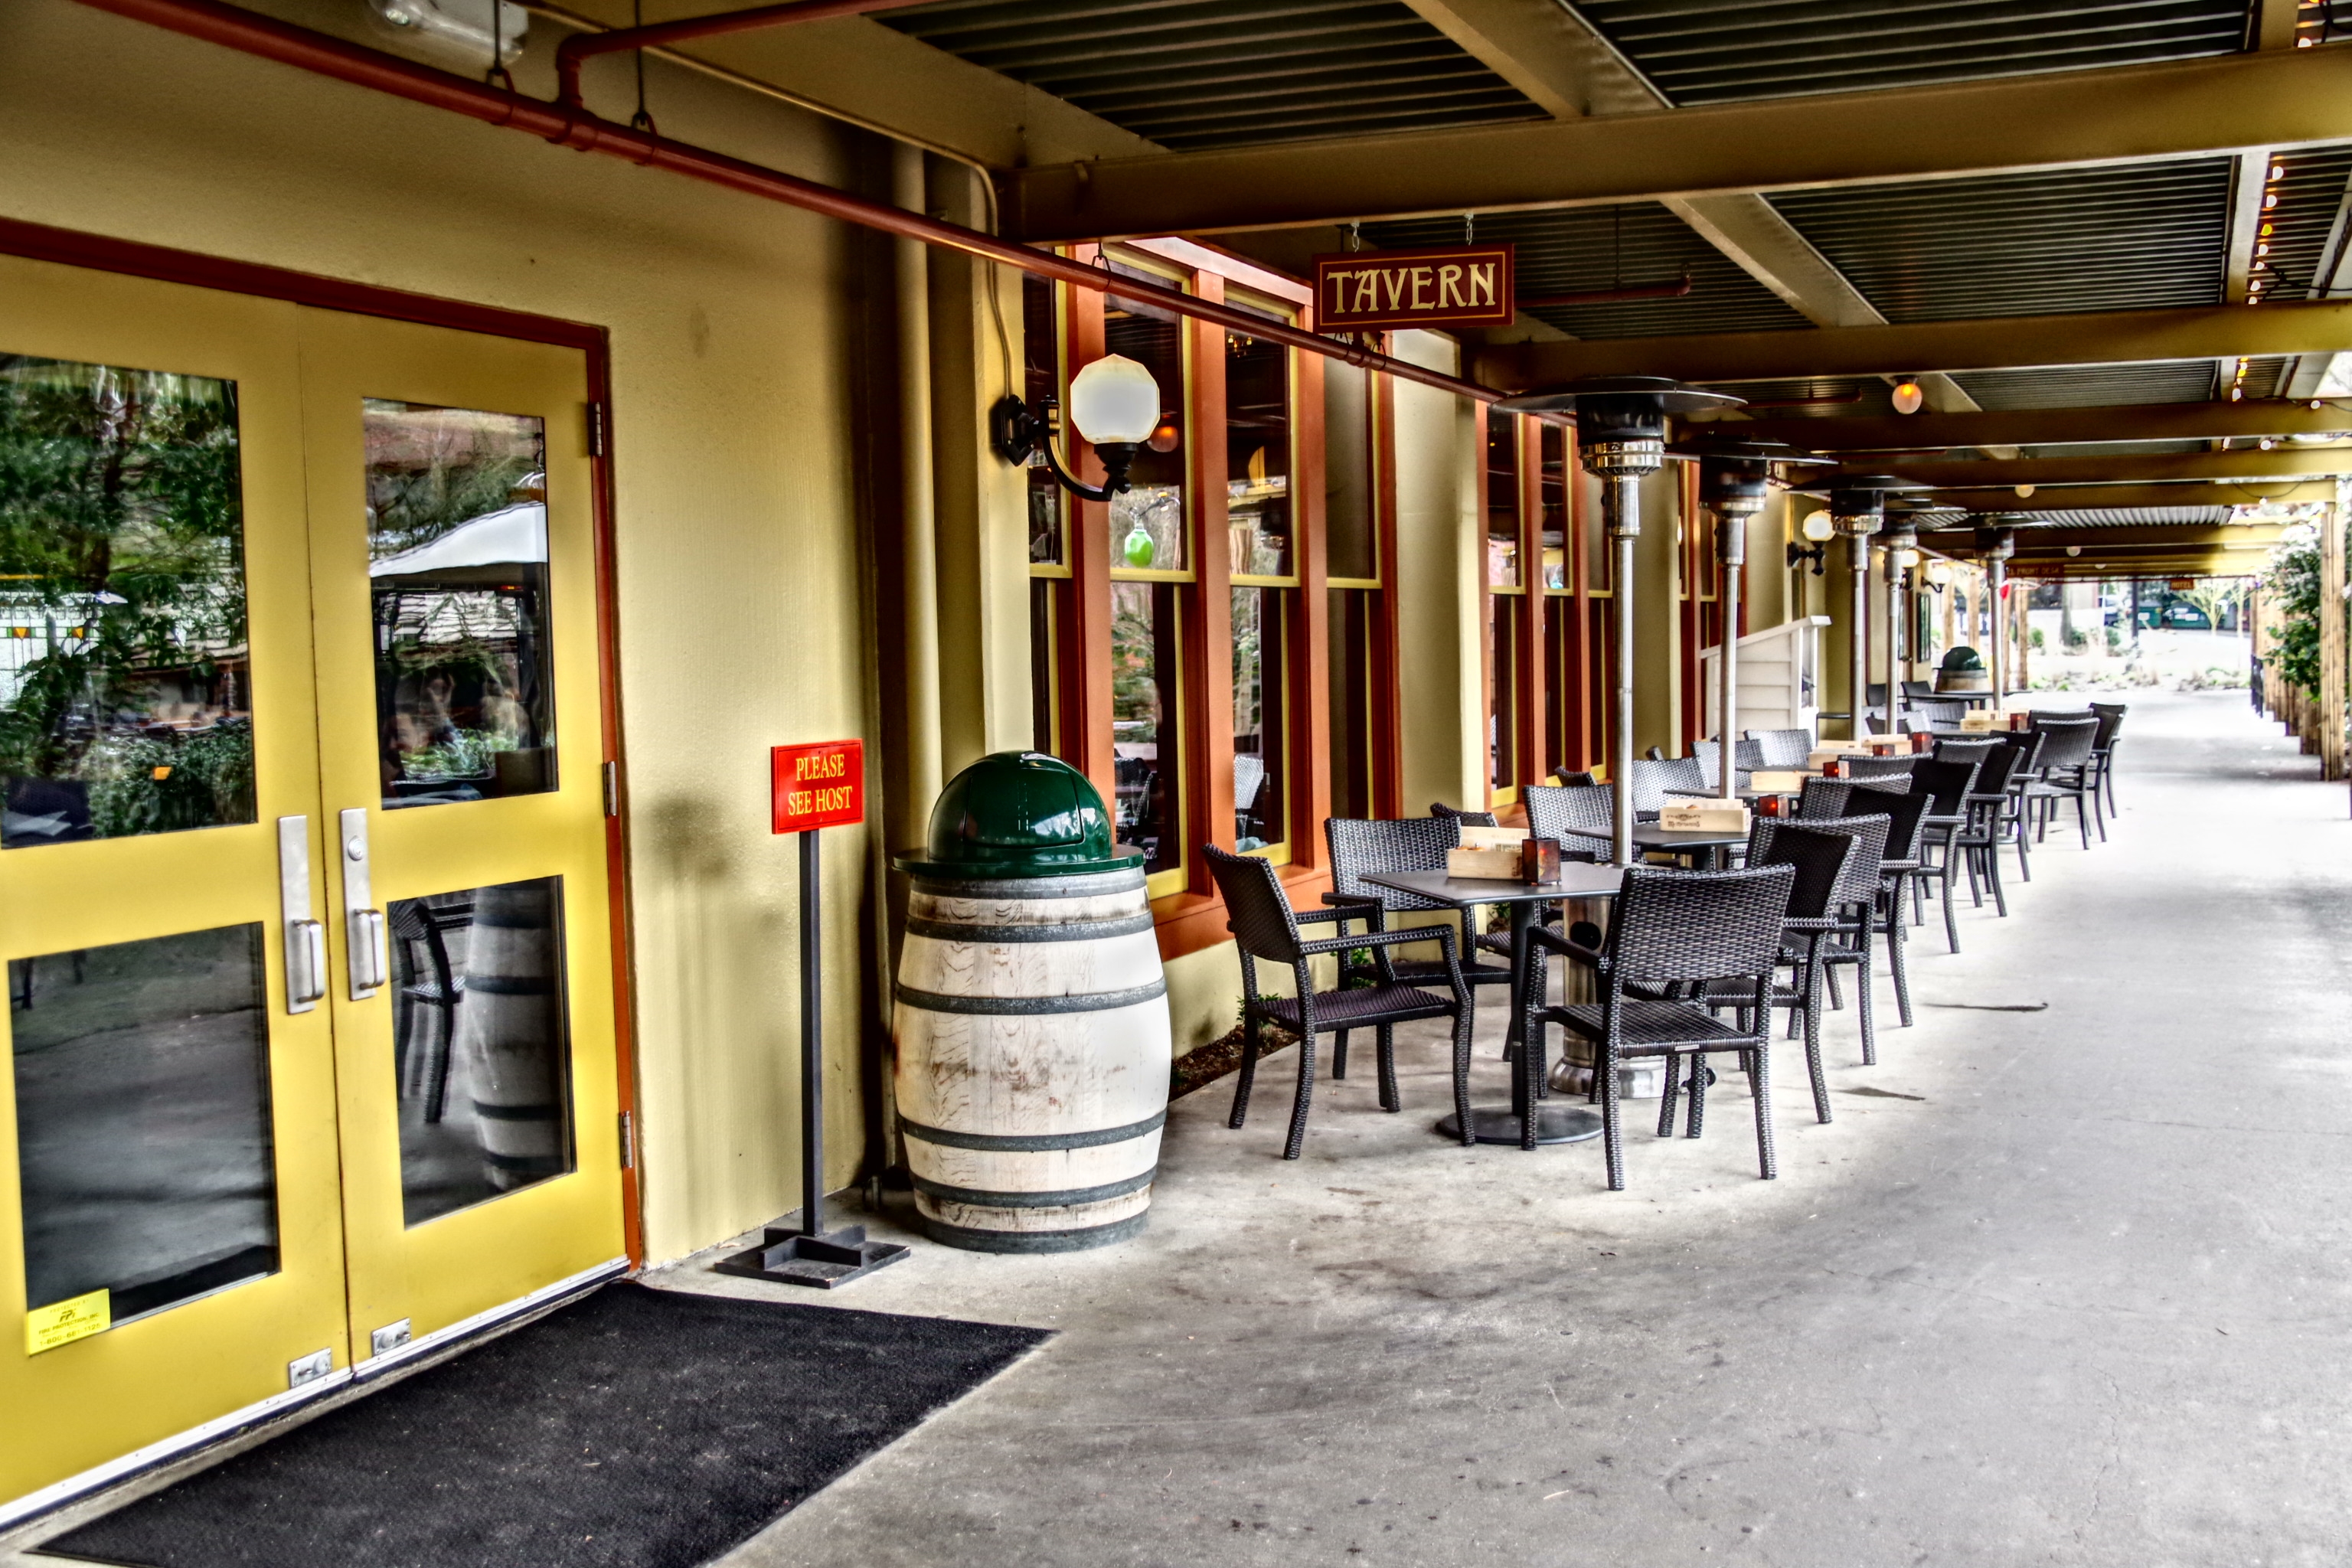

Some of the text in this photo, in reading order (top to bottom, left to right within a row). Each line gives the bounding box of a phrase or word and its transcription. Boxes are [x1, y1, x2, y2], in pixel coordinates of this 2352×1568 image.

[1327, 263, 1496, 314] TAVERN
[795, 753, 845, 781] PLEASE
[788, 786, 852, 816] SEE HOST
[38, 1327, 51, 1335] FIRE
